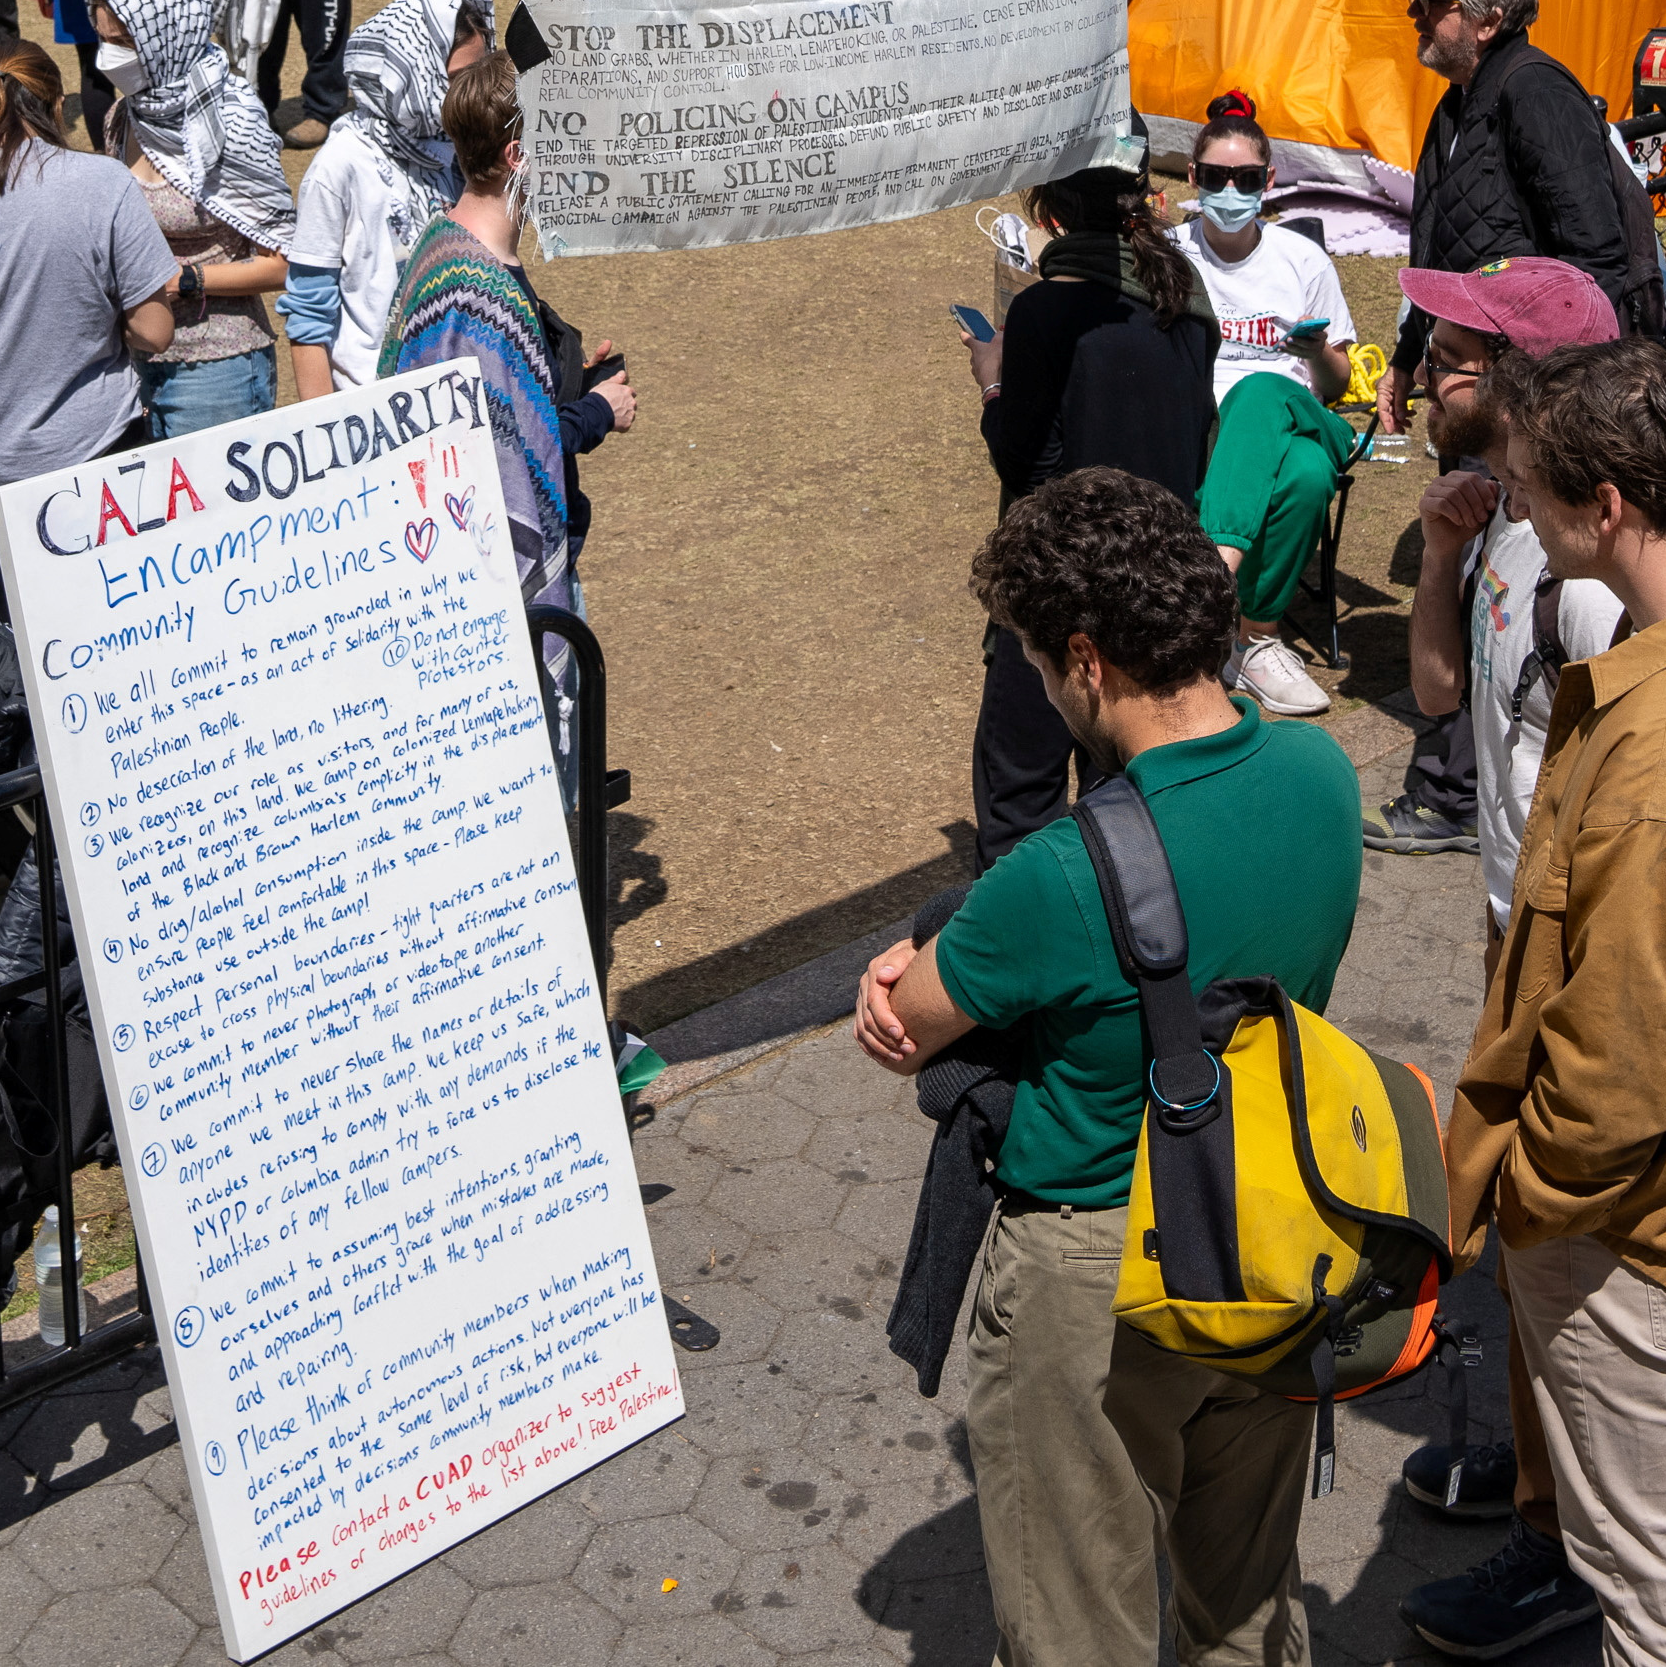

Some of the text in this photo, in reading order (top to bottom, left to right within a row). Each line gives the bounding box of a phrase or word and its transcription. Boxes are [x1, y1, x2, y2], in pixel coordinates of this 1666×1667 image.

[544, 0, 895, 51] STOP THE DISPLACEMENT
[1653, 48, 1666, 78] 1
[534, 81, 911, 138] NO POLICING ON CAMPUS
[537, 150, 837, 200] END THE SILENCE
[34, 368, 487, 558] GAZA SOLIDARITY
[222, 539, 398, 616] Guidelines
[92, 690, 123, 717] We
[129, 668, 157, 704] all
[239, 641, 259, 664] to
[269, 622, 319, 655] remain
[323, 588, 393, 637] grounded
[397, 586, 413, 602] in
[419, 572, 448, 599] why
[456, 567, 479, 585] we
[410, 645, 451, 671] with
[412, 630, 434, 652] Do
[461, 607, 510, 651] engage
[106, 792, 129, 816] No
[135, 757, 218, 805] desecration
[221, 746, 238, 771] of
[242, 734, 270, 761] the
[306, 718, 326, 737] no
[331, 695, 394, 728] littering.
[109, 732, 193, 780] Palestinian
[142, 992, 205, 1044] Respect
[292, 931, 377, 973] boundaries
[391, 905, 423, 941] tight
[428, 881, 486, 926] quarters
[490, 870, 515, 890] are
[540, 850, 561, 869] an
[240, 1042, 301, 1084] member
[309, 1014, 362, 1047] without
[371, 998, 401, 1023] their
[411, 962, 486, 1006] affirmative
[490, 931, 547, 970] consent.
[195, 1230, 271, 1284] identities
[278, 1209, 299, 1242] of
[307, 1202, 331, 1232] any
[343, 1176, 391, 1211] fellow
[235, 1340, 359, 1414] and repairing.
[237, 1539, 322, 1602] Please
[397, 1495, 412, 1513] a
[415, 1452, 474, 1502] CUAD
[481, 1412, 553, 1469] organizer
[556, 1402, 574, 1424] to
[579, 1360, 643, 1408] suggest
[259, 1371, 679, 1628] guidelines or changes to the list above! Free Palestine!
